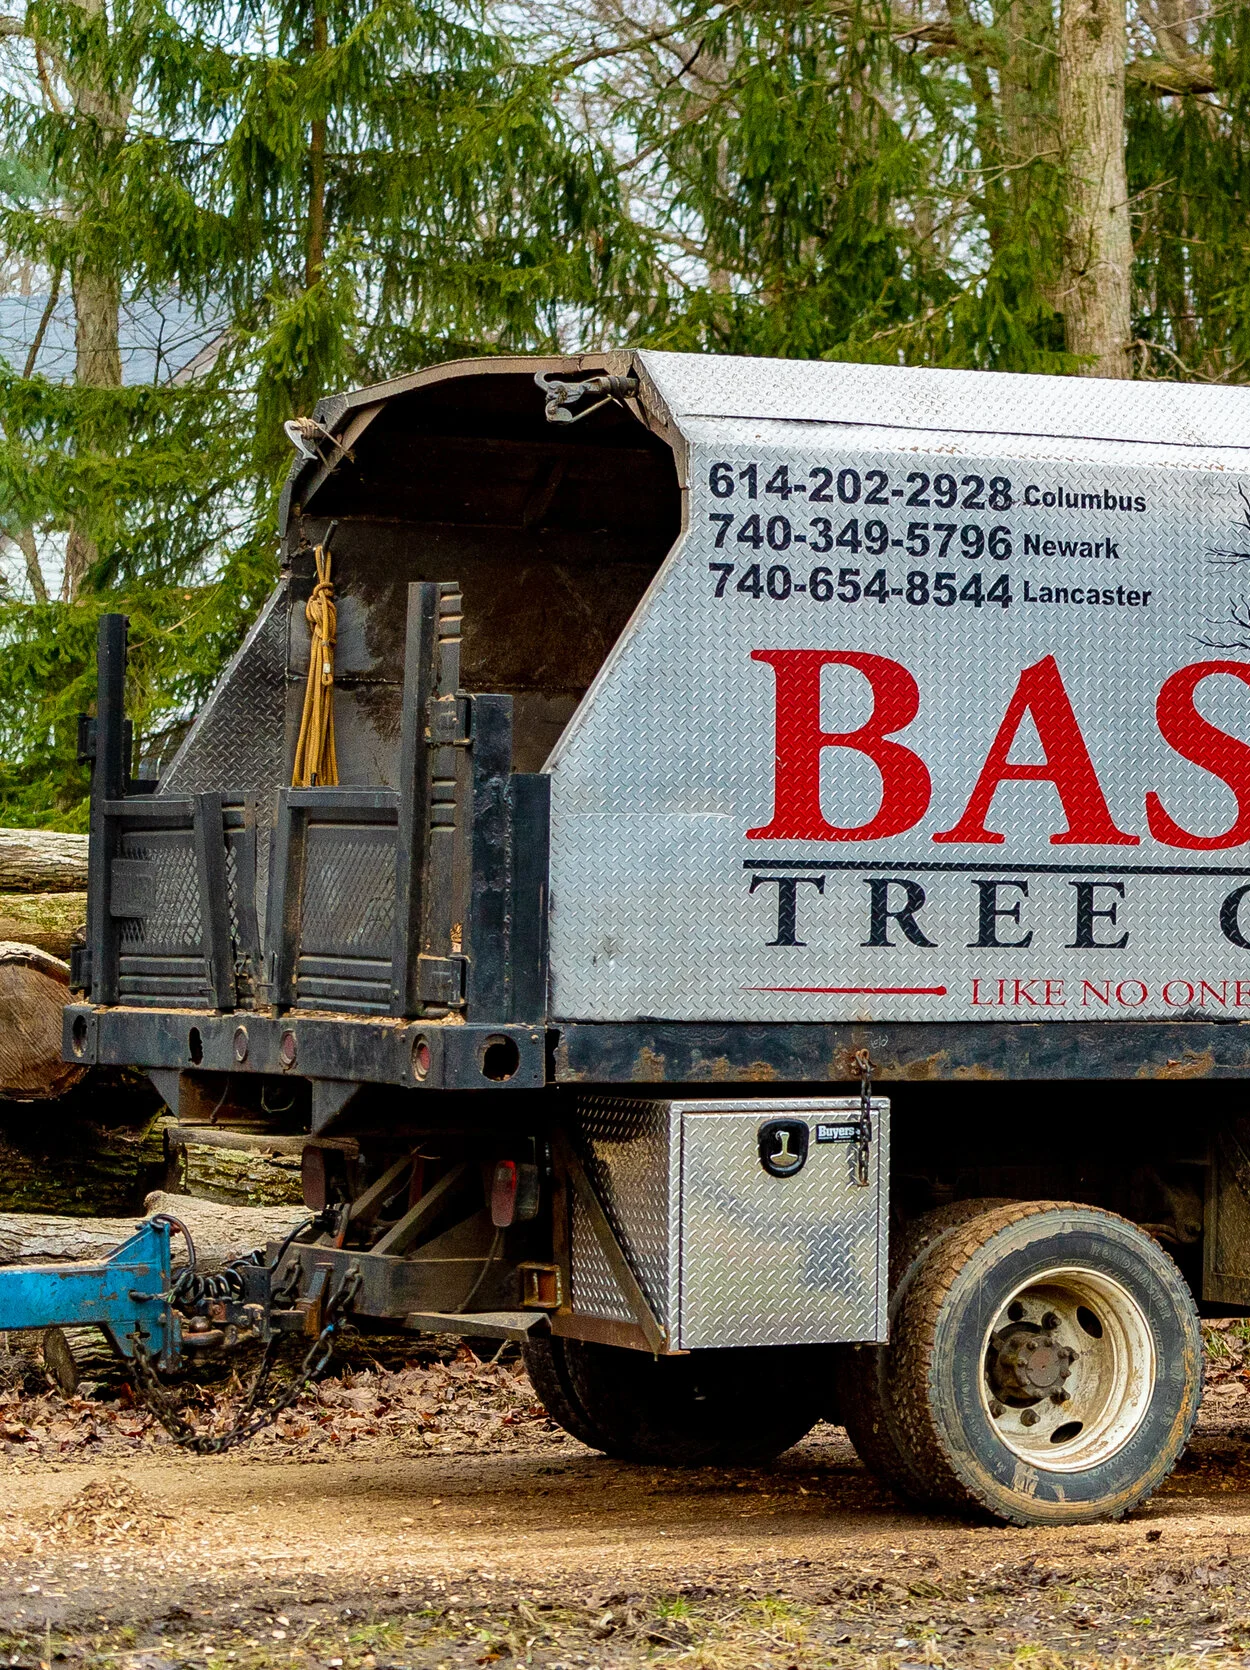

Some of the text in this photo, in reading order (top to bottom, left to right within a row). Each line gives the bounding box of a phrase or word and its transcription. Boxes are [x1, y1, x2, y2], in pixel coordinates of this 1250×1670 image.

[708, 462, 1147, 514] 614-202-2928 Columbus
[709, 513, 1120, 561] 740-349-5796 Newark
[709, 563, 1152, 609] 740-654-8544 Lancaster
[749, 873, 1131, 949] TREE
[970, 978, 1067, 1006] LIKE
[1081, 979, 1147, 1007] NO
[818, 1126, 855, 1140] Buyers
[1090, 1242, 1172, 1320] ROADMASTER
